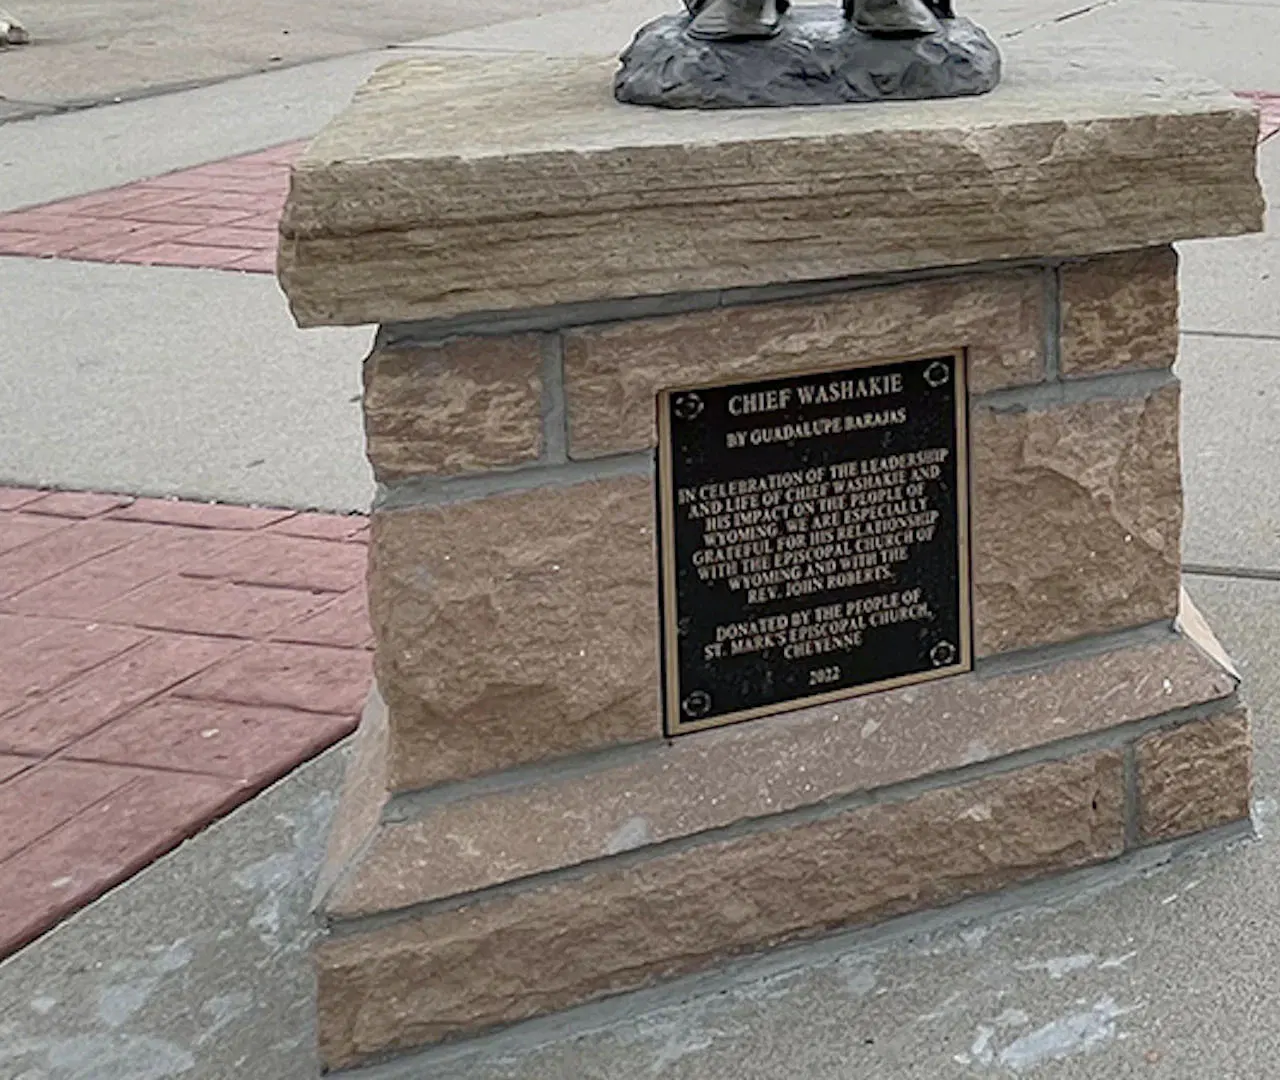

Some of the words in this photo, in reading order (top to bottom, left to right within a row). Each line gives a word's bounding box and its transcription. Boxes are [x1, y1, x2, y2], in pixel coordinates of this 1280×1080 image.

[728, 388, 792, 416] CHIEF
[797, 373, 903, 405] WASHAKIE
[726, 431, 748, 448] BY
[750, 416, 843, 445] GUADALUPE
[844, 407, 907, 431] BARAJAS
[678, 487, 697, 505] IN
[699, 470, 803, 500] CELEBRATION
[806, 466, 826, 483] OF
[829, 461, 859, 480] THE
[860, 448, 949, 475] LEADERSHIP
[688, 500, 723, 519] AND
[726, 494, 760, 512] LIFE
[762, 489, 782, 506] OF
[785, 482, 830, 502] CHIEF
[832, 470, 907, 494] WASHAKIE
[910, 464, 941, 481] AND
[705, 514, 731, 532] HIS
[733, 504, 790, 527] IMPACT
[793, 500, 815, 517] ON
[818, 494, 848, 512] THE
[850, 486, 903, 508] PEOPLE
[906, 481, 926, 498] OF
[785, 517, 808, 533] WE
[811, 511, 840, 529] ARE
[843, 496, 928, 524] ESPECIALLY
[692, 539, 774, 566] GRATEFUL
[776, 533, 807, 552] FOR
[809, 528, 835, 546] HIS
[836, 510, 940, 541] RELATIONSHIP
[697, 561, 738, 580] WITH
[742, 556, 771, 574] THE
[774, 541, 853, 568] EPISCOPAL
[854, 529, 914, 553] CHURCH
[916, 525, 936, 541] OF
[728, 565, 801, 591] WYOMING
[804, 559, 836, 577] AND
[839, 551, 878, 570] WITH
[880, 545, 909, 563] THE
[748, 584, 783, 604] REV.
[786, 577, 824, 597] JOHN
[716, 614, 788, 642] DONATED
[791, 608, 812, 627] BY
[814, 603, 843, 622] THE
[845, 592, 900, 617] PEOPLE
[901, 587, 921, 605] OF
[704, 642, 728, 660] ST.
[730, 631, 787, 656] MARK'S
[789, 616, 866, 643] EPISCOPAL
[783, 630, 862, 659] CHEYENNE
[809, 665, 841, 686] 2022
